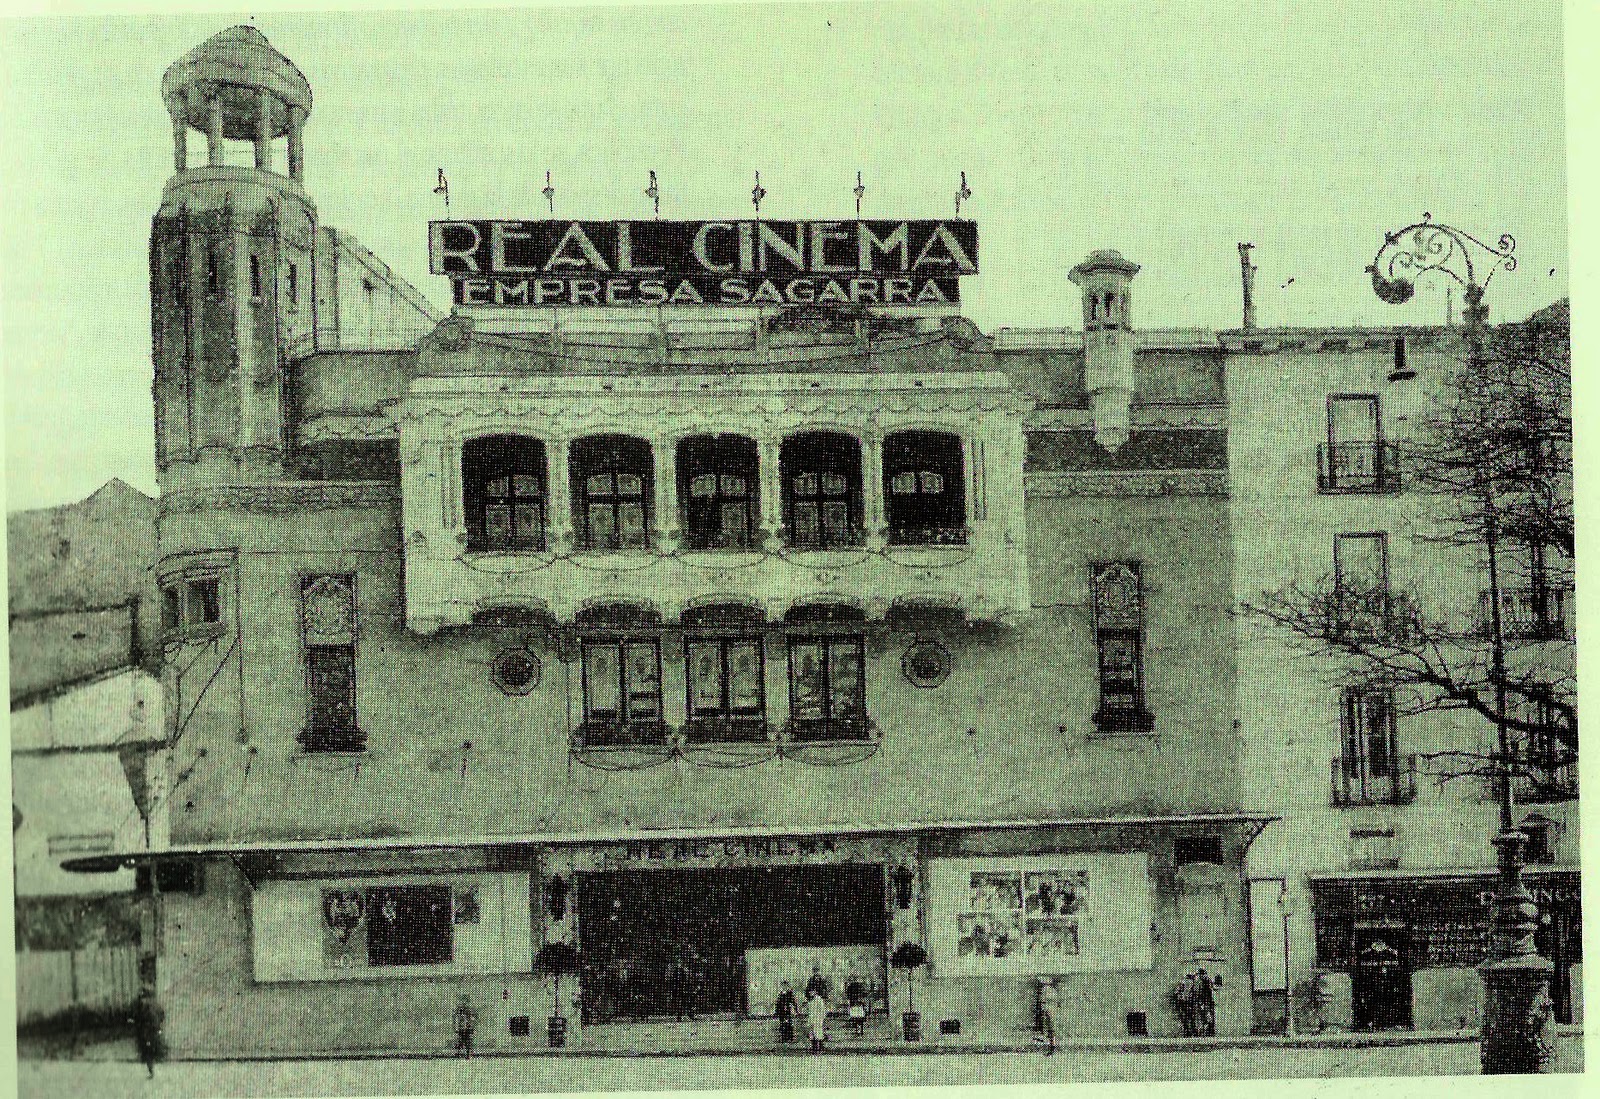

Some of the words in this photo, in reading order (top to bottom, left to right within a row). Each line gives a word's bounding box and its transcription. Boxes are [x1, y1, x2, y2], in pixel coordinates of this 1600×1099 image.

[430, 221, 664, 273] REAL
[692, 221, 978, 273] CINEMA
[463, 278, 703, 305] EMPRESA
[719, 277, 950, 304] SAGARRA
